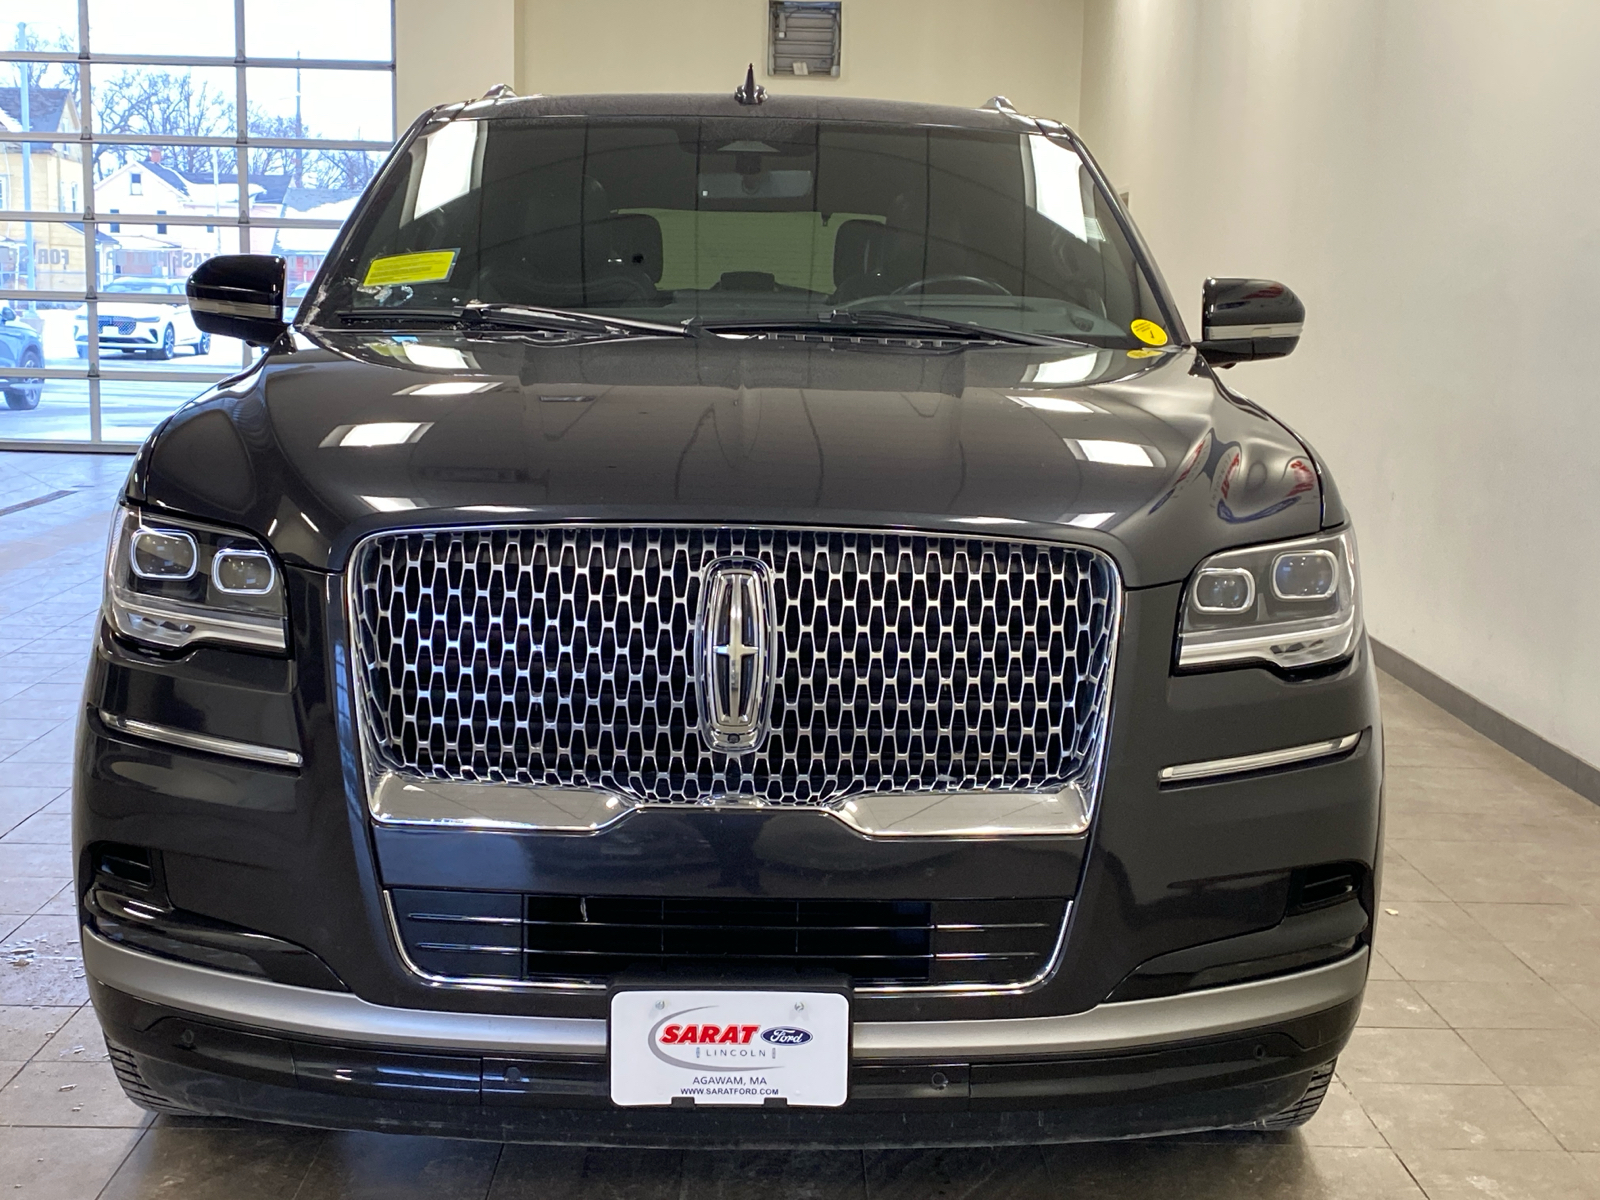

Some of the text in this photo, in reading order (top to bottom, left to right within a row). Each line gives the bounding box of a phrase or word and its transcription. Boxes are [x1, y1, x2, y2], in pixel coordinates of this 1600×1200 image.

[659, 1023, 761, 1045] SARAT
[769, 1029, 804, 1044] Ford
[706, 1049, 766, 1057] LINCOLN
[692, 1077, 768, 1086] AGAWAM, MA
[680, 1088, 779, 1096] WWW.SARATFORD.COM
